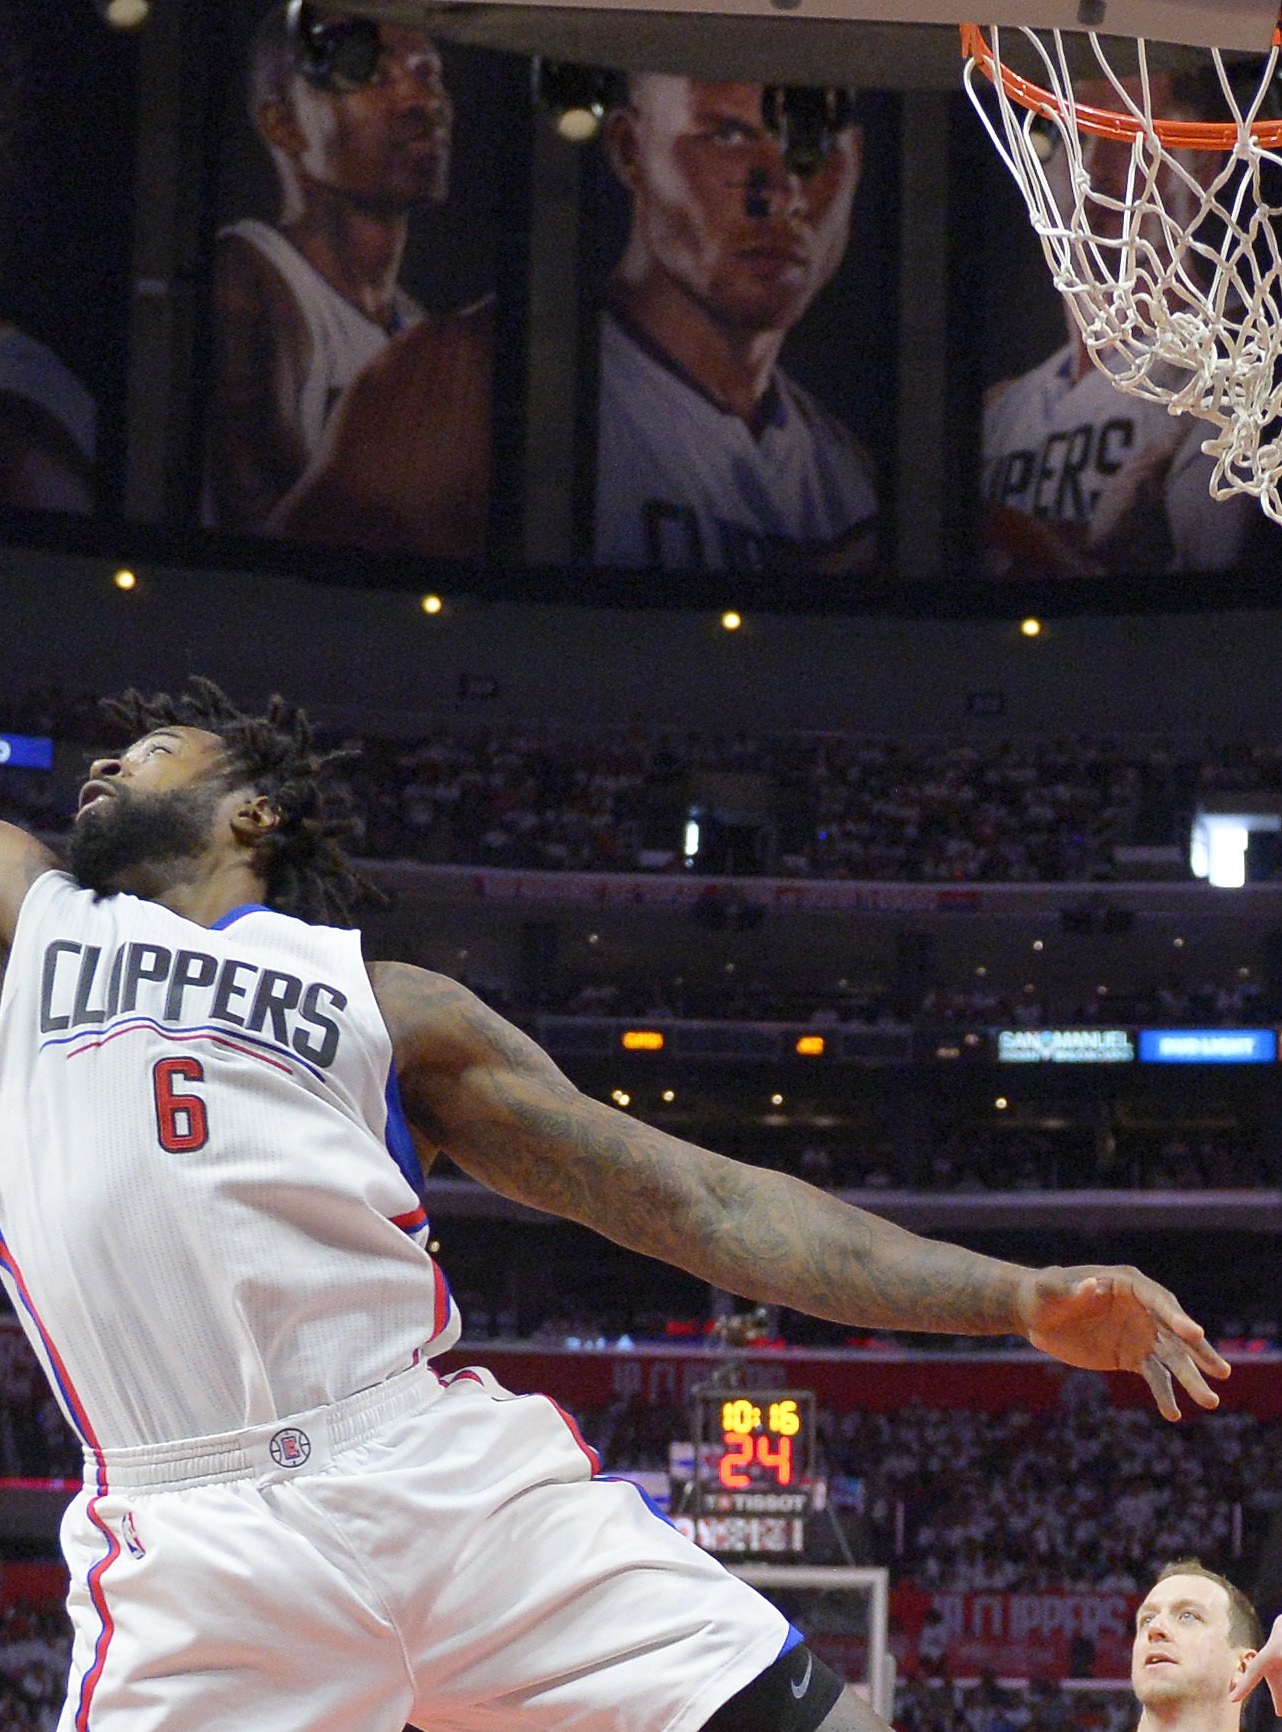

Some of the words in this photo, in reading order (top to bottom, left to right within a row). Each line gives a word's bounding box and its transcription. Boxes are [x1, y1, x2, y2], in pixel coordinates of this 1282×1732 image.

[40, 938, 348, 1069] CLIPPERS
[999, 1030, 1041, 1049] SAN
[1052, 1030, 1131, 1049] MANUEL
[152, 1055, 209, 1154] 6
[722, 1399, 800, 1435] 10:16
[719, 1431, 792, 1488] 24
